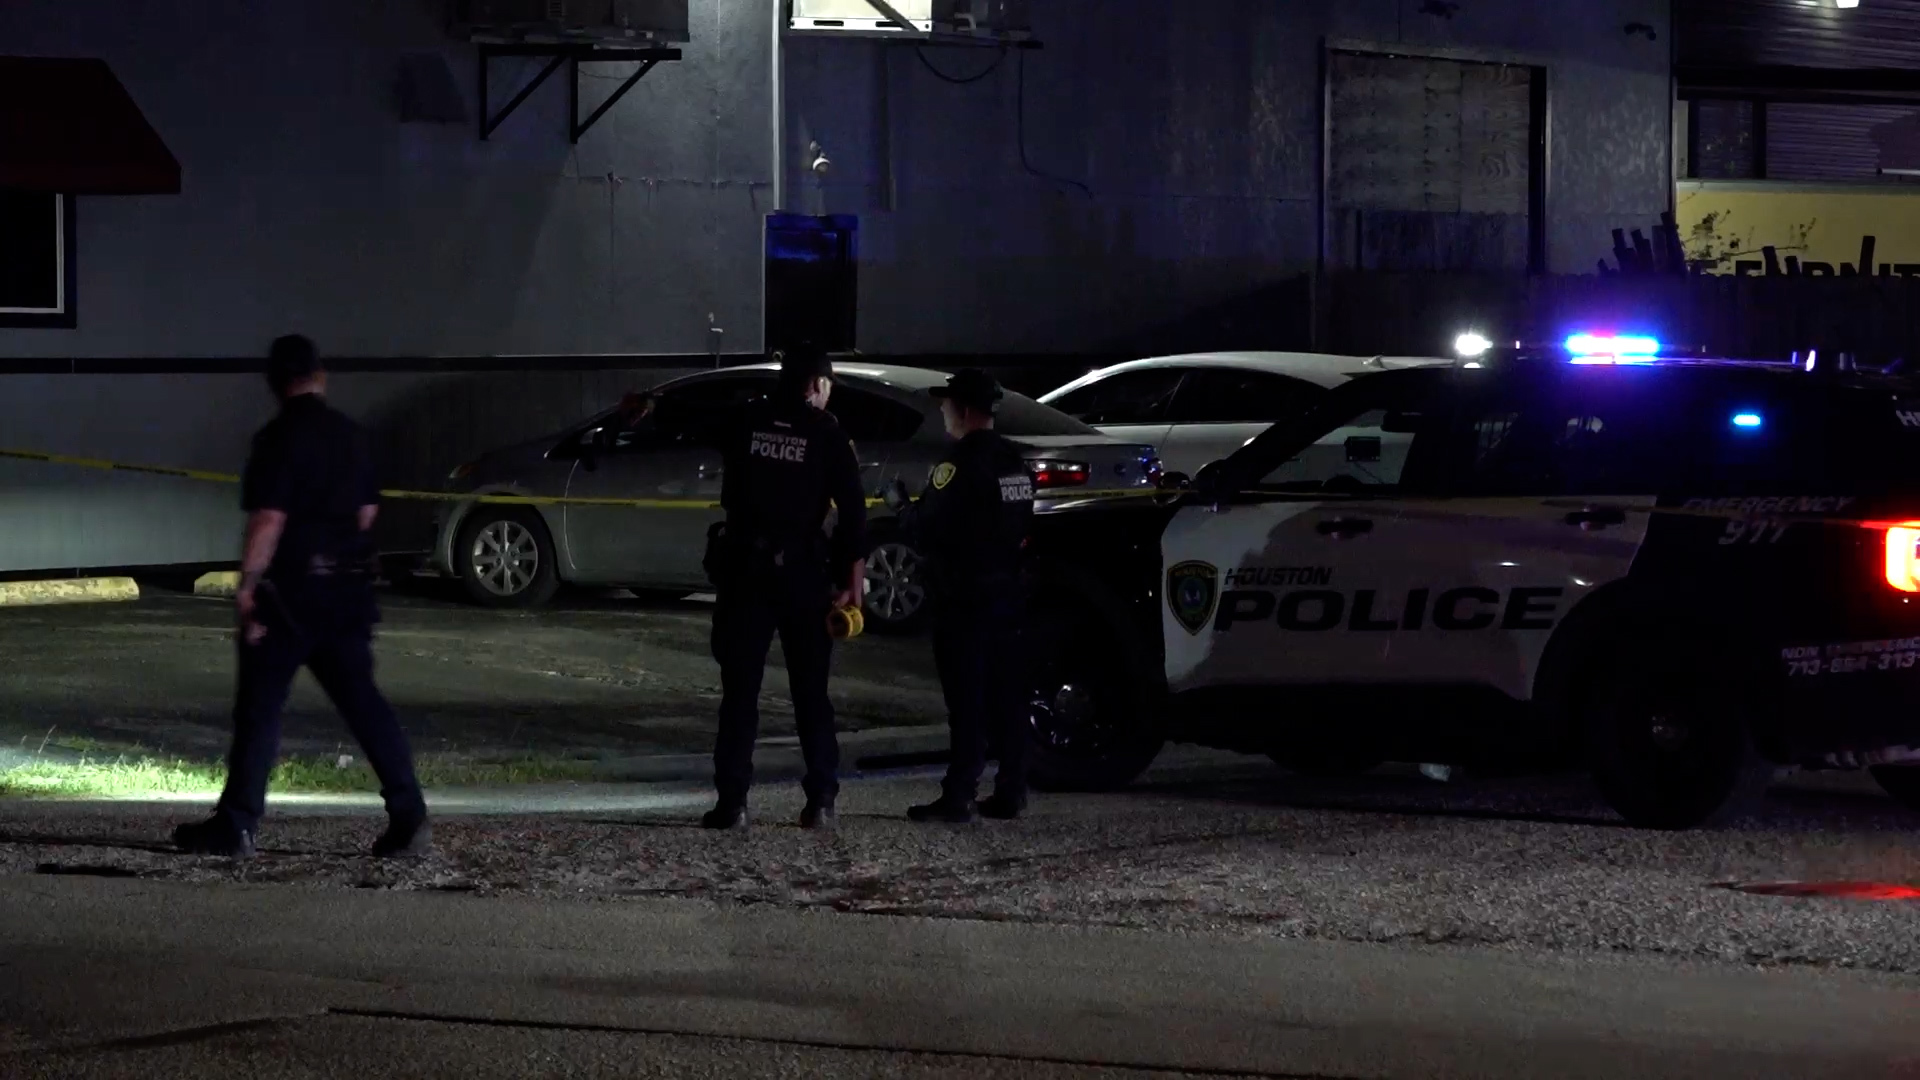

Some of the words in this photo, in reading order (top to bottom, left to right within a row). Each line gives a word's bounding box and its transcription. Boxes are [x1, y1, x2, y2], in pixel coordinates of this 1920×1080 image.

[750, 440, 806, 462] POLICE
[1224, 566, 1332, 586] HOUSTON
[1213, 586, 1565, 632] POLICE
